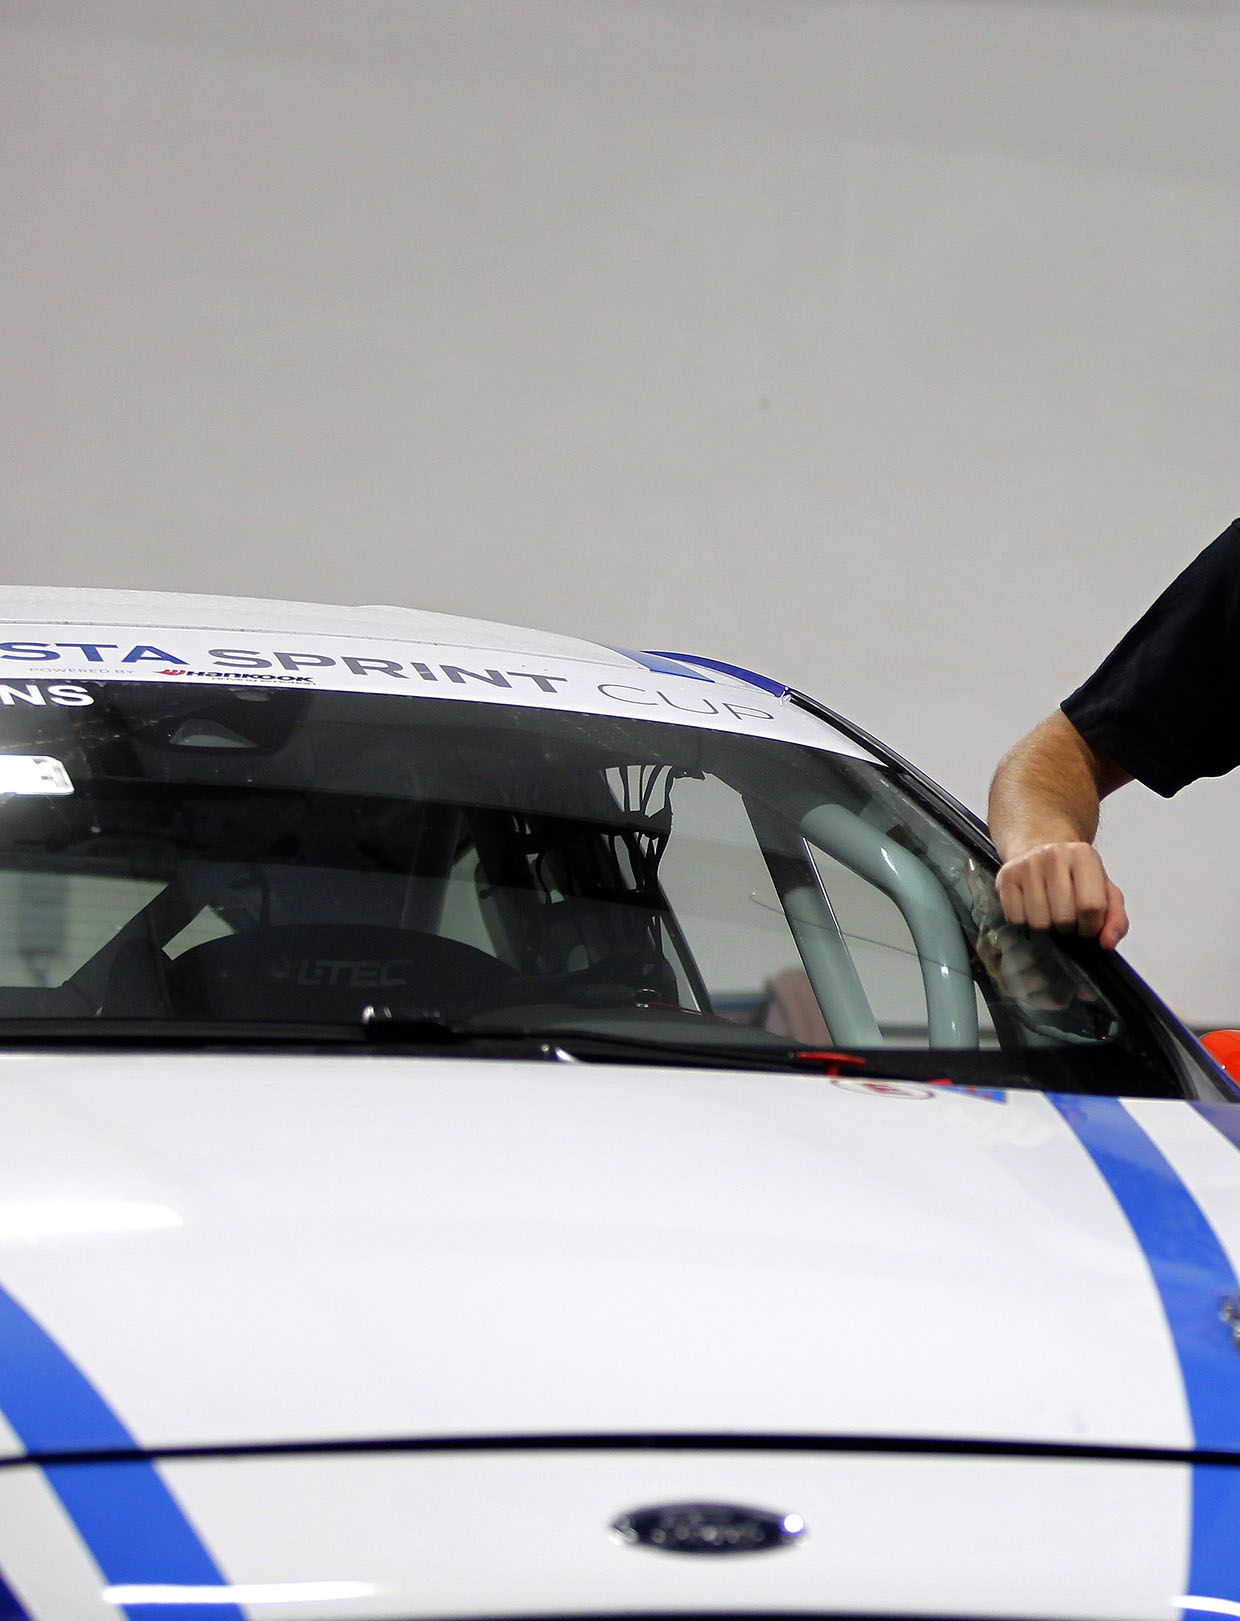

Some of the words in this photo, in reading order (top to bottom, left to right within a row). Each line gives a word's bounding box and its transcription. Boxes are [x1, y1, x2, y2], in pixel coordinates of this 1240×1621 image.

[0, 641, 191, 666] STA
[208, 648, 569, 694] SPRINT
[597, 684, 775, 721] CUP
[0, 684, 96, 707] NS
